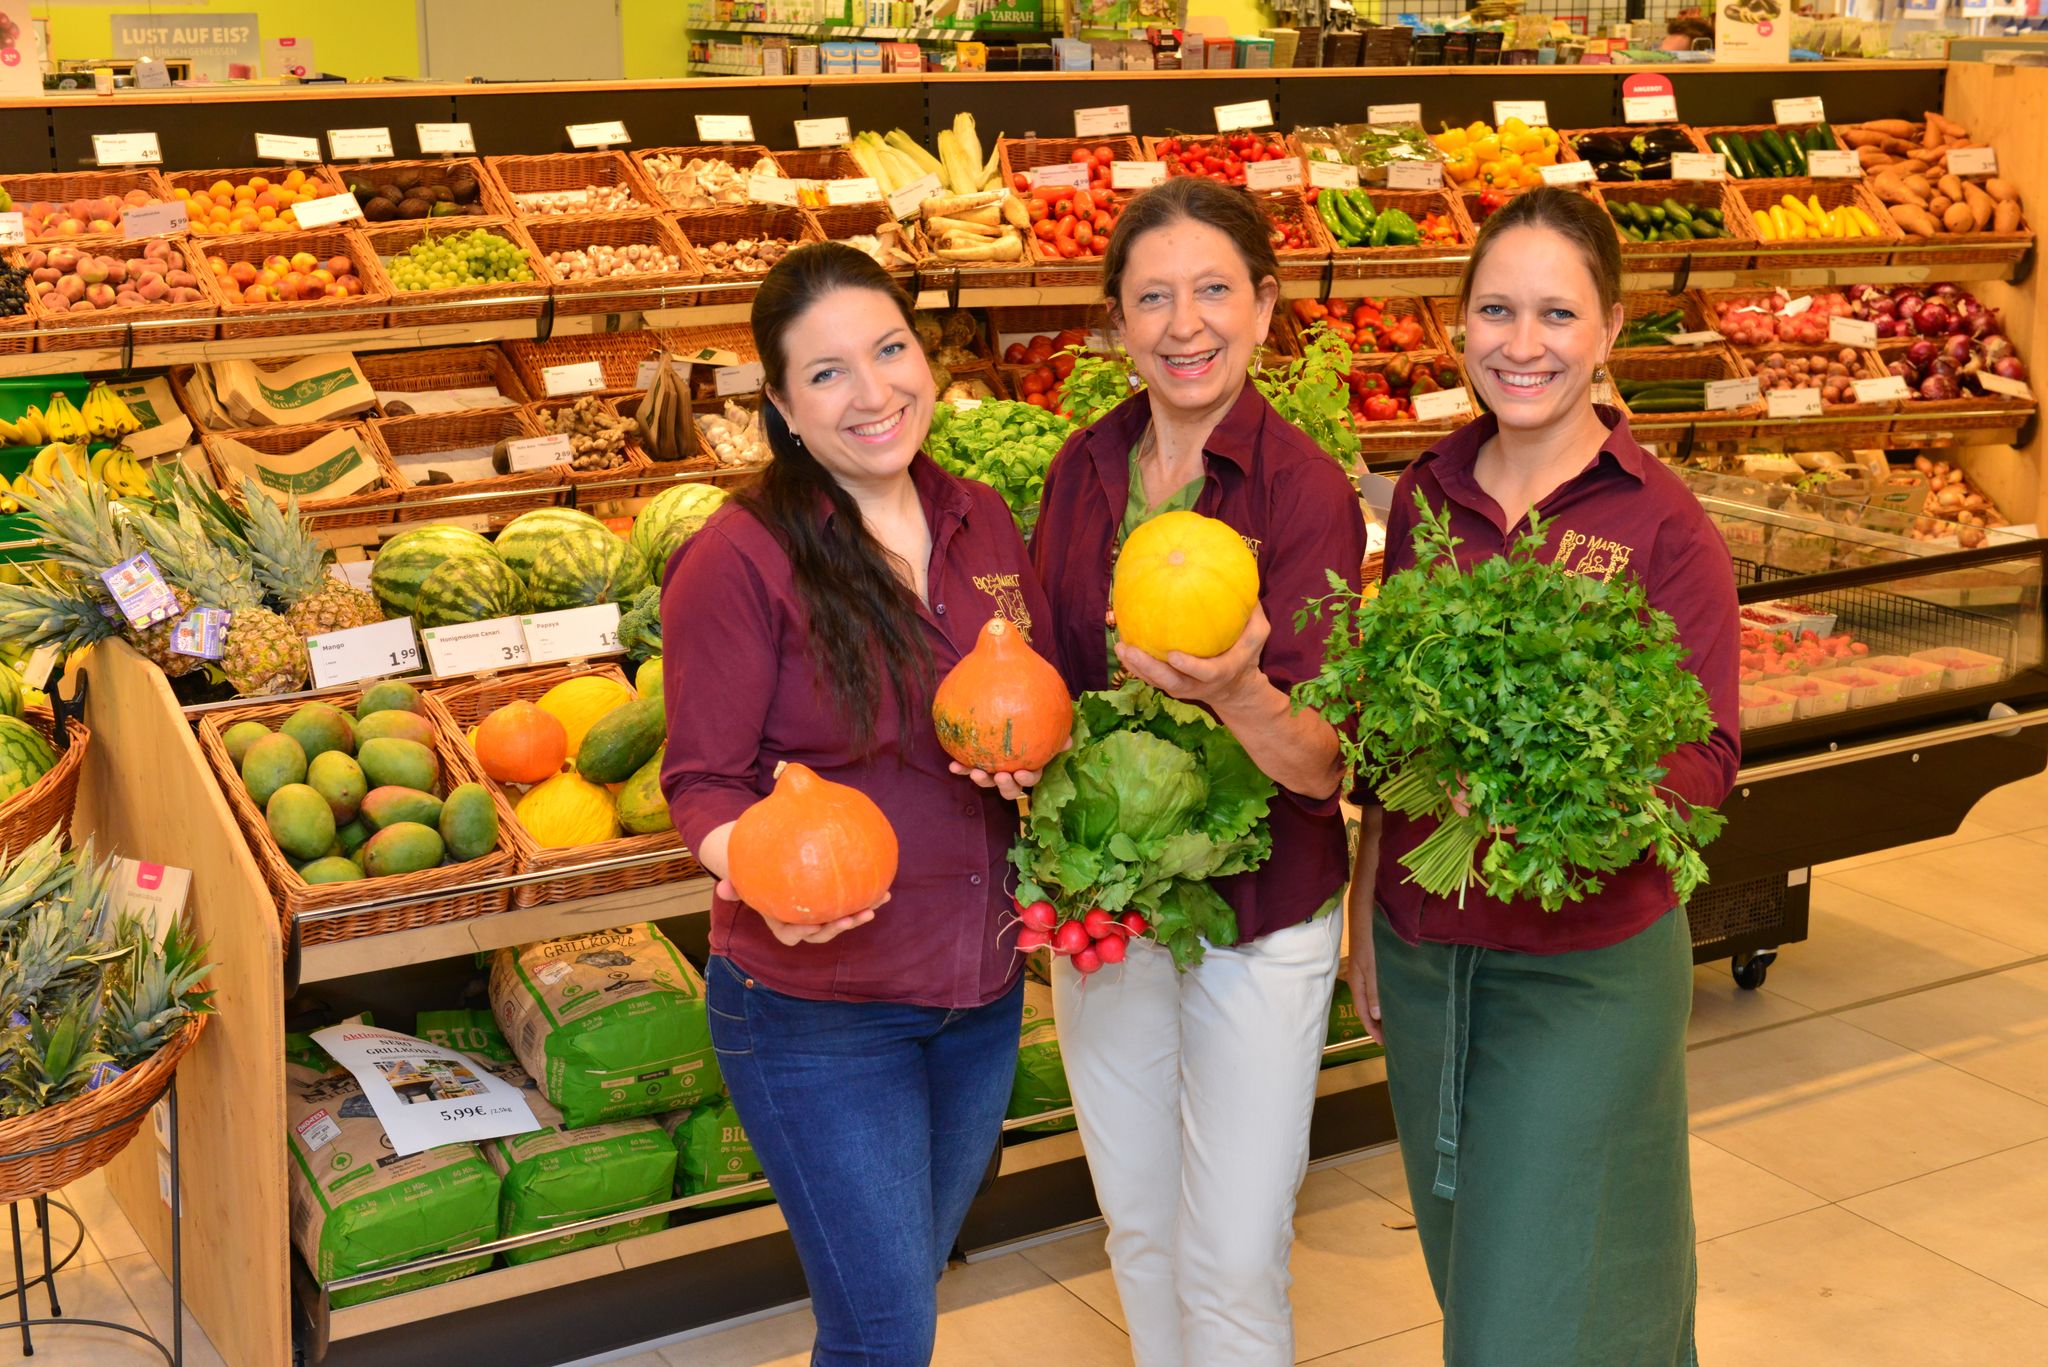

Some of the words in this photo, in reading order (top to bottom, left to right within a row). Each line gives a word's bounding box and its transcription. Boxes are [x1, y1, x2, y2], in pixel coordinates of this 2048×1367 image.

[991, 10, 1034, 22] YARRAH
[122, 28, 168, 44] LUST
[172, 27, 209, 44] AUF
[213, 26, 250, 43] EIS?
[1240, 535, 1262, 550] RKT
[1564, 529, 1587, 545] BIO
[1587, 535, 1634, 558] MARKT
[537, 621, 559, 629] Papaya
[600, 631, 618, 646] 1.2
[322, 643, 345, 651] Mango
[389, 648, 416, 667] 1.99
[543, 934, 637, 959] GRILLKOHLE
[440, 1105, 487, 1121] 5,99€
